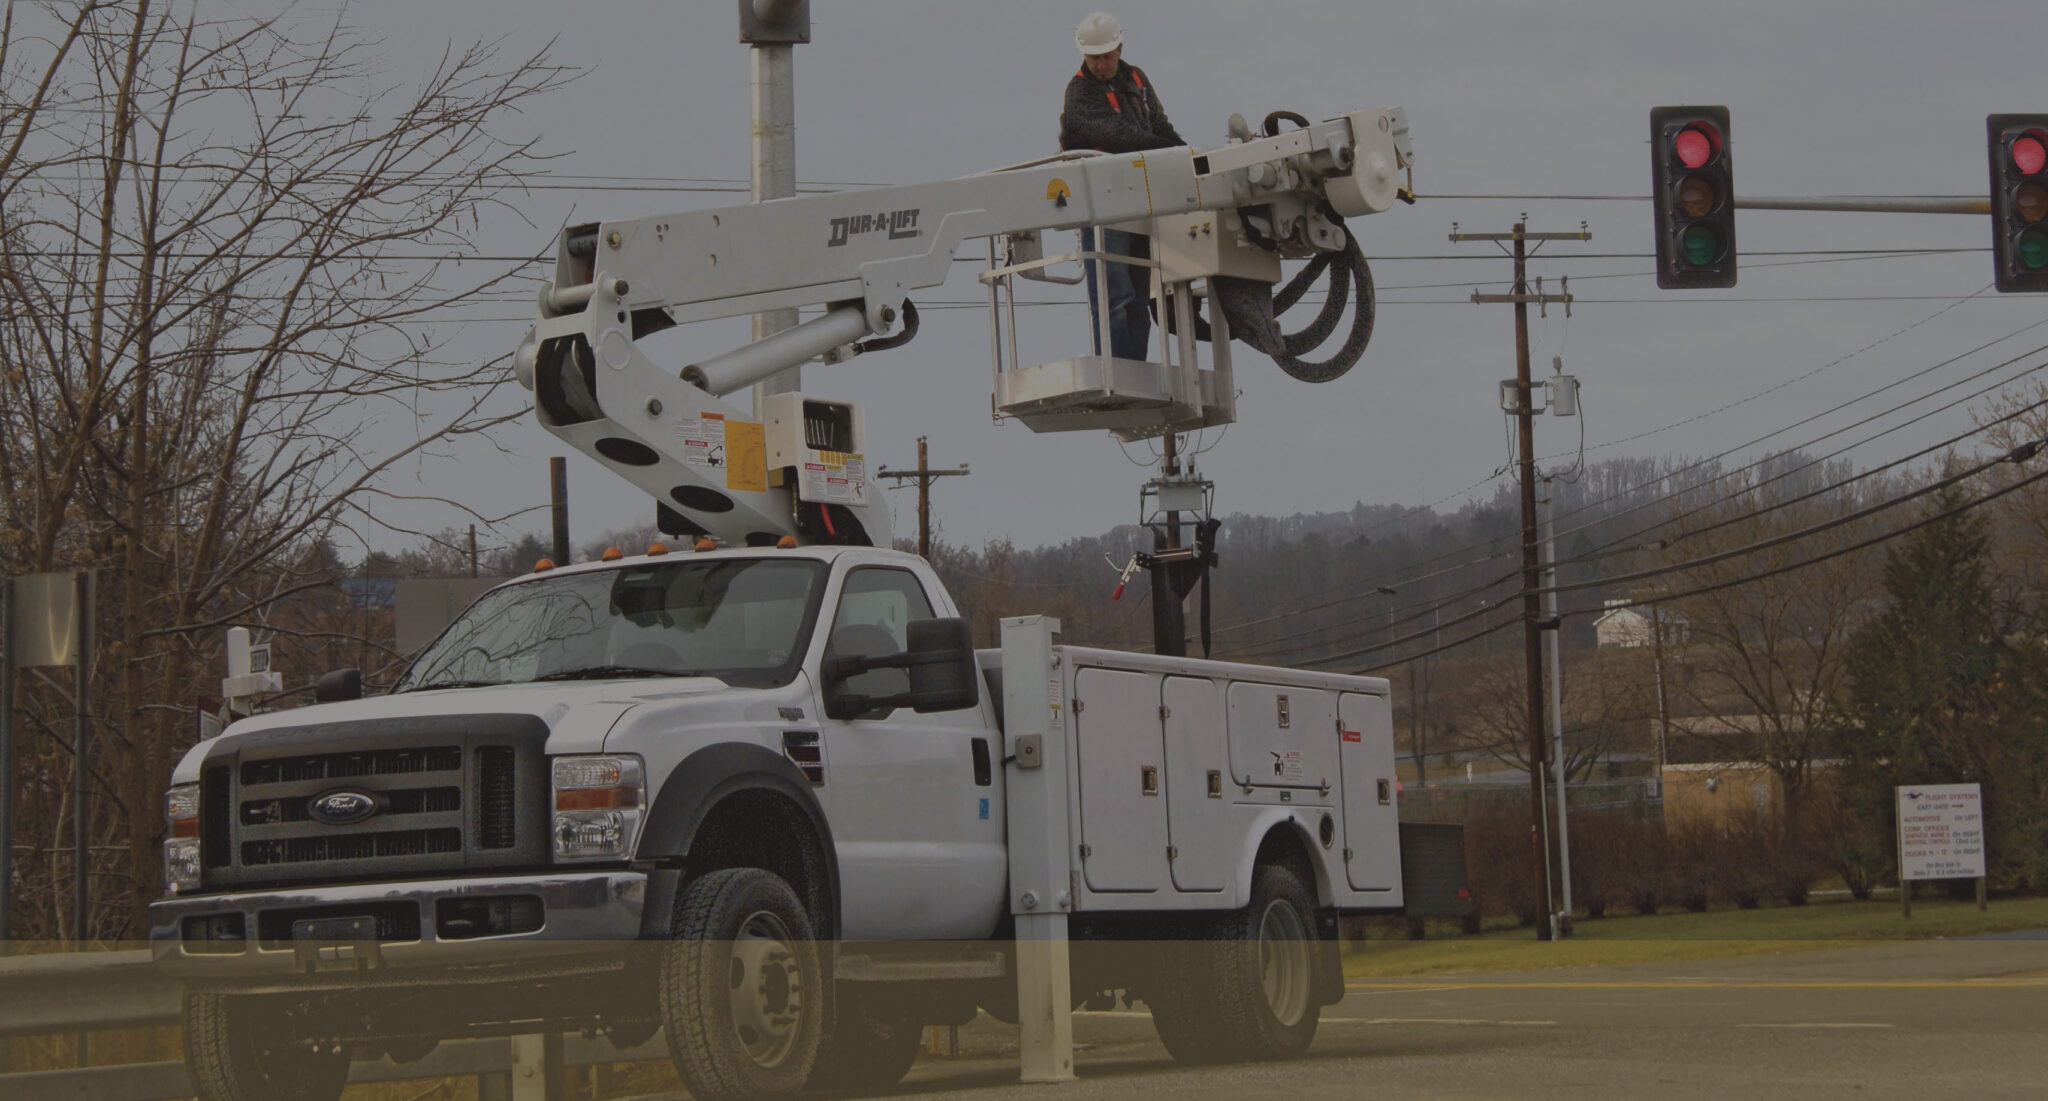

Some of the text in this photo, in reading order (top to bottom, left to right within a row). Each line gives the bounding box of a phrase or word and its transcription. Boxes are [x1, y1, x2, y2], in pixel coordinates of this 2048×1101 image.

[1949, 792, 1978, 800] SYSTEMS
[327, 797, 357, 808] Ford
[1904, 815, 1940, 823] AUTOMOTIVE
